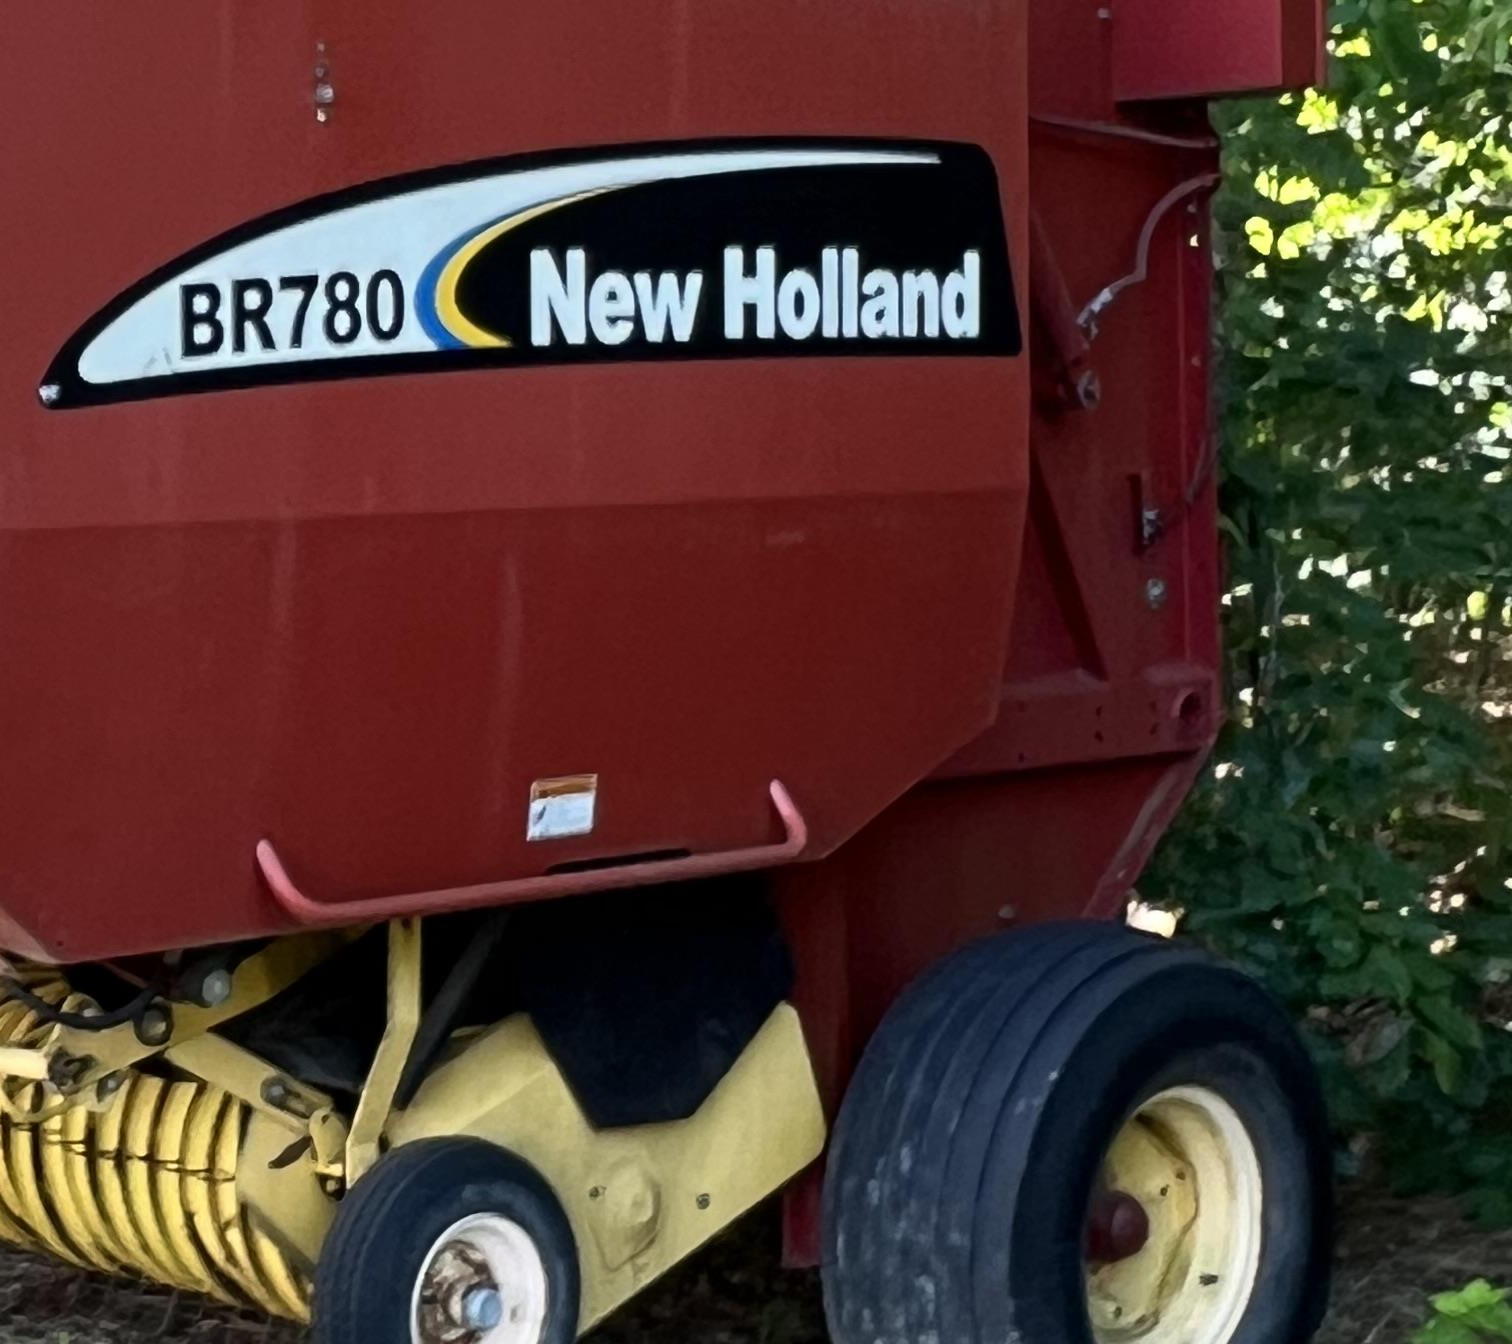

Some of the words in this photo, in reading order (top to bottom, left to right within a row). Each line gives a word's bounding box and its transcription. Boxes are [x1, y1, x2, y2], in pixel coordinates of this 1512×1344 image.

[180, 269, 405, 359] BR780
[529, 248, 703, 346] New
[723, 245, 981, 341] Holland
